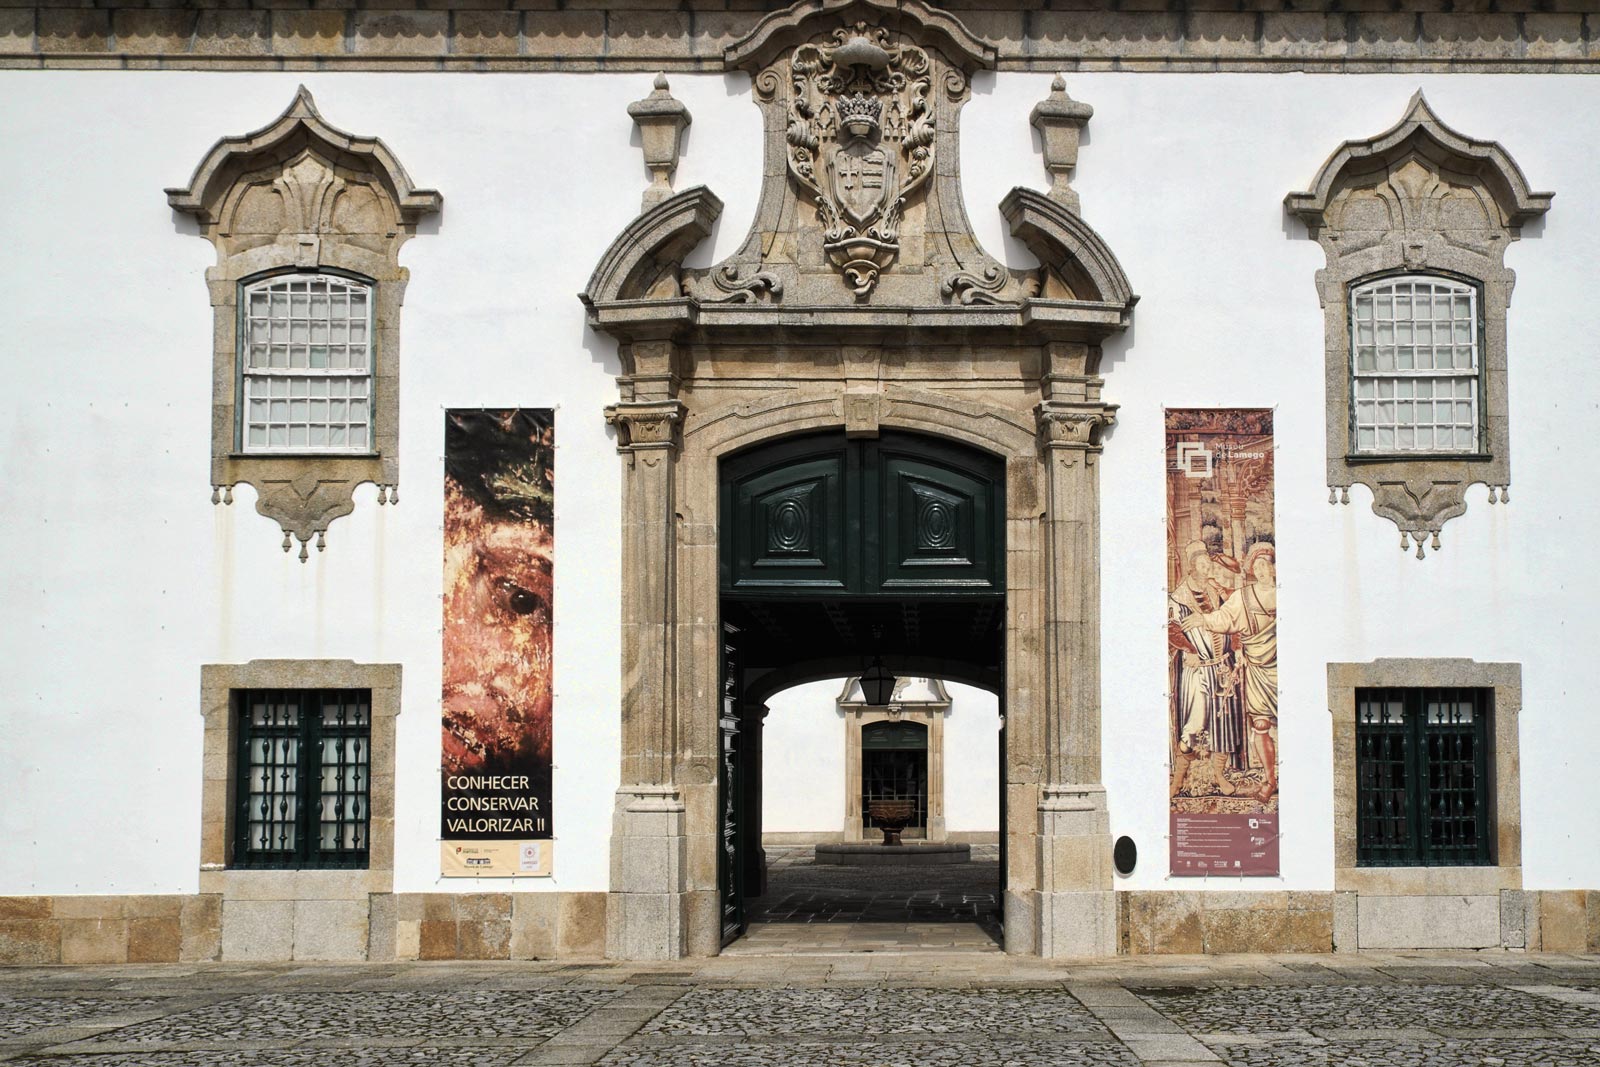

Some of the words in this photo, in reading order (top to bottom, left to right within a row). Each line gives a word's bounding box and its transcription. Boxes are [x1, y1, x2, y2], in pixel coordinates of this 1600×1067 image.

[1216, 451, 1227, 459] de
[1229, 451, 1265, 460] Lamego
[447, 776, 529, 790] CONHECER
[447, 797, 539, 811] CONSERVAR
[447, 818, 533, 833] VALORIZAR
[537, 818, 545, 832] II
